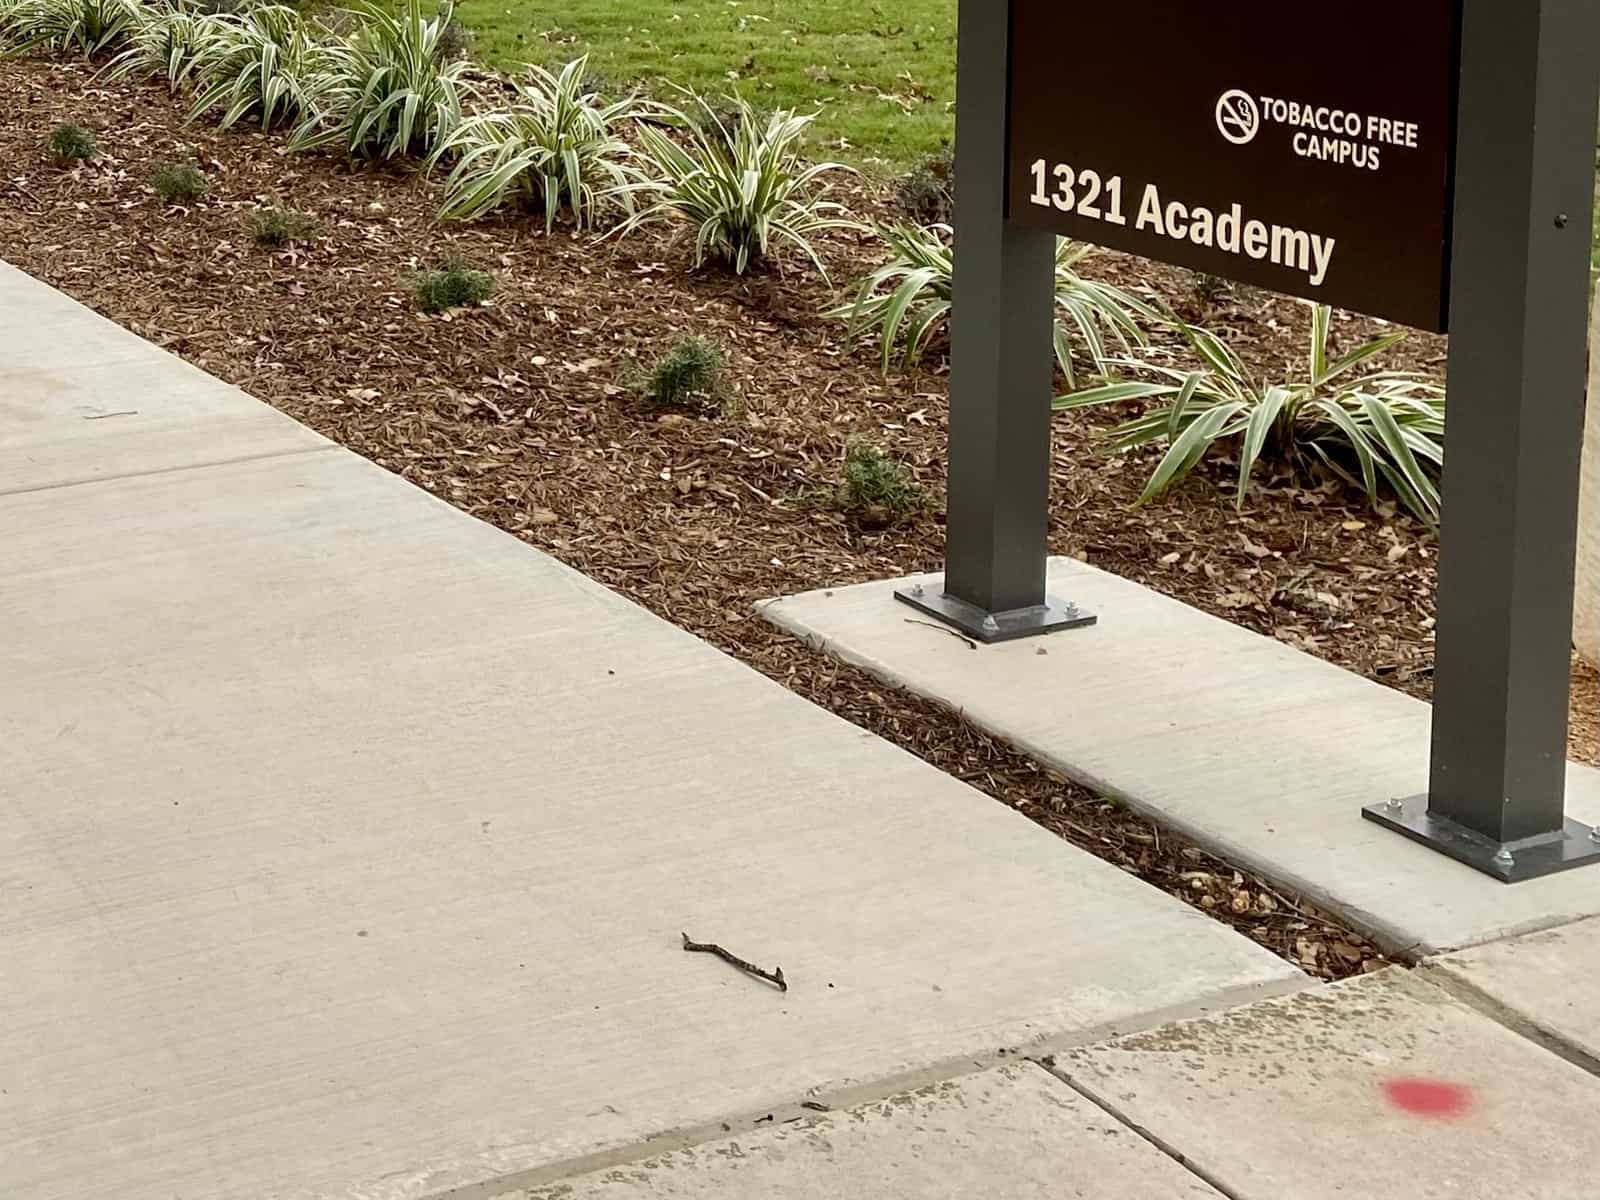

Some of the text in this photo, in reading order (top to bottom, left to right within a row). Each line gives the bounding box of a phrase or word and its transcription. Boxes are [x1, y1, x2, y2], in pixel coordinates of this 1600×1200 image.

[1260, 96, 1418, 148] TOBACCO FREE
[1292, 133, 1380, 170] CAMPUS
[1030, 158, 1336, 286] 1321 Academy
